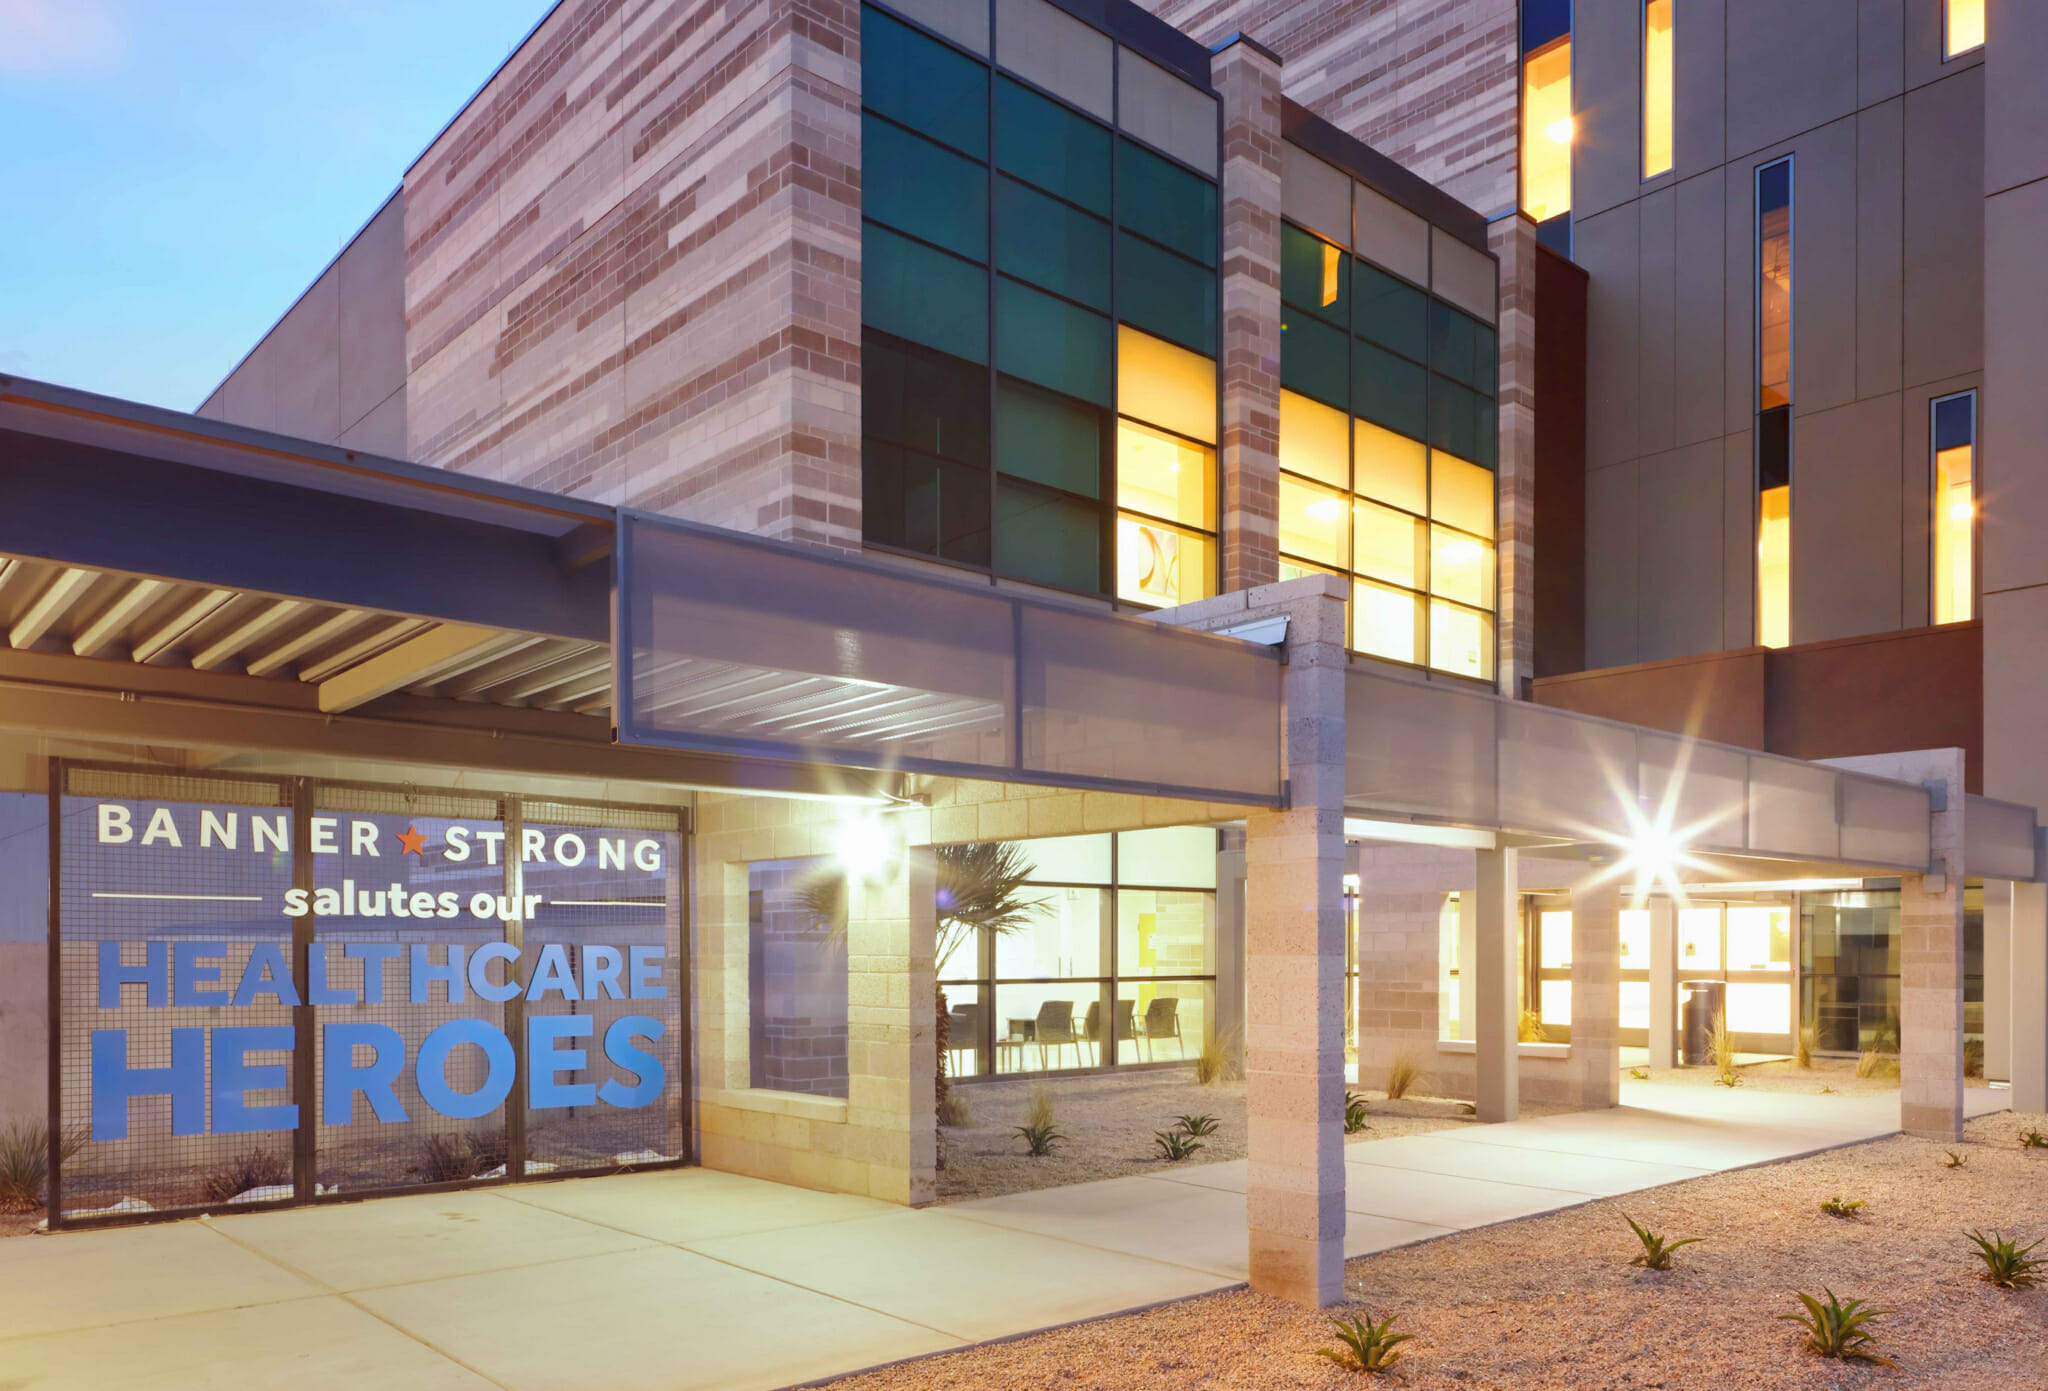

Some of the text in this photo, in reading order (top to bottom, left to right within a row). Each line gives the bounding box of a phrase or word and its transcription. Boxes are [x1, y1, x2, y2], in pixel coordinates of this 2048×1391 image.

[97, 803, 662, 873] BANNER STRONG
[282, 879, 543, 921] salutes our
[98, 941, 667, 1009] HEALTHCARE
[91, 1014, 667, 1142] HEROES
